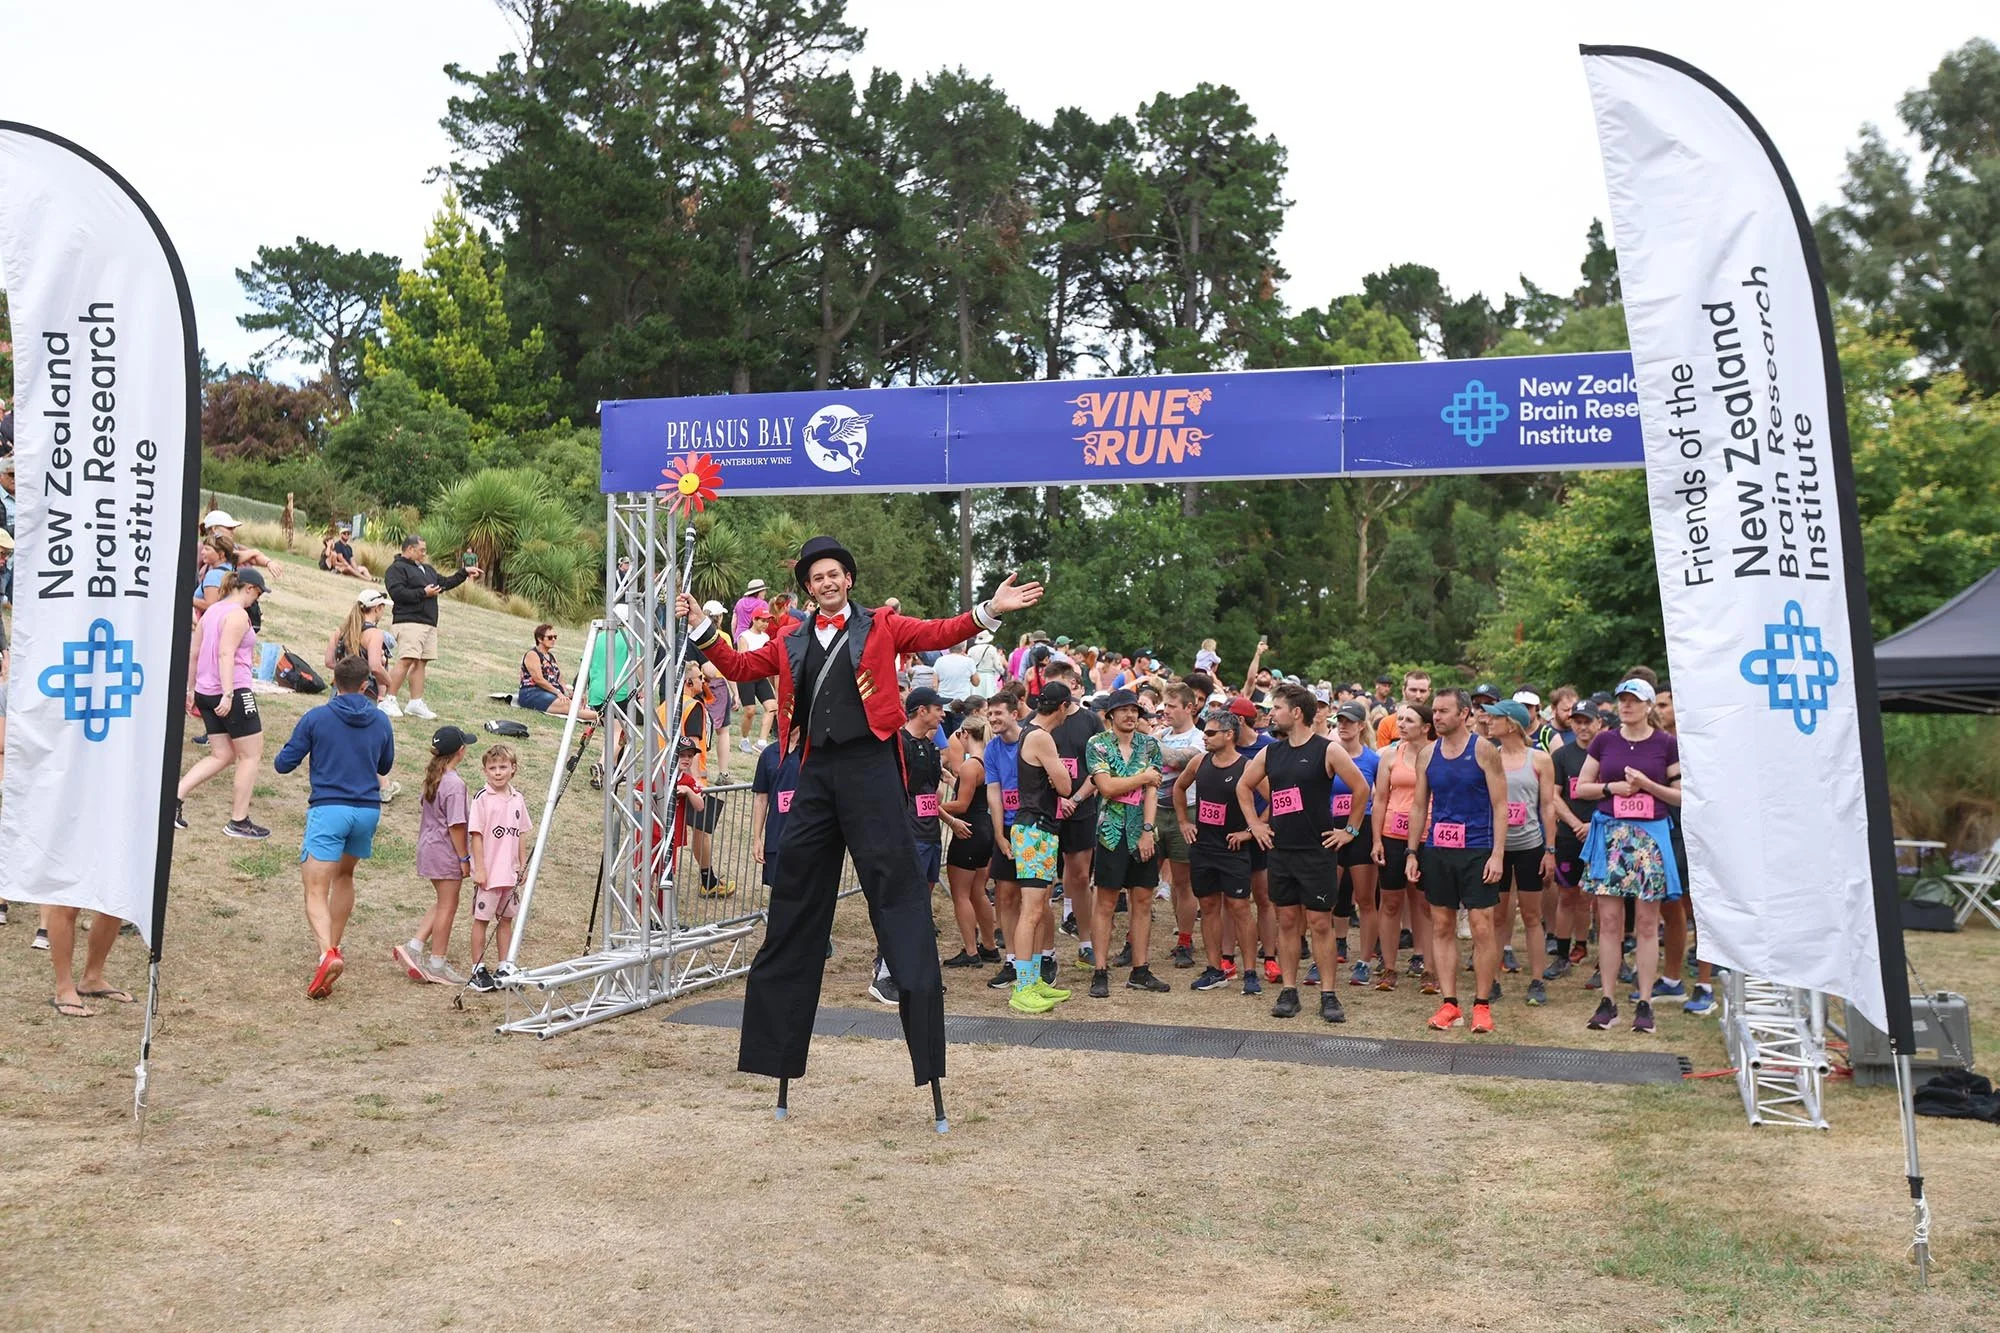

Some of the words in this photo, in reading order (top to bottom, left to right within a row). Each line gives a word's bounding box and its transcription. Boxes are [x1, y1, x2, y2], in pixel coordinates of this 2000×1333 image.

[1741, 265, 1785, 455] Research
[78, 302, 117, 484] Research
[1519, 377, 1572, 398] New
[1665, 364, 1697, 418] the
[1701, 300, 1761, 473] Zealand
[42, 331, 73, 497] Zealand
[1087, 388, 1190, 428] VINE
[1519, 399, 1578, 421] Brain
[1585, 398, 1639, 419] Rese
[666, 418, 749, 450] PEGASUS
[758, 416, 795, 447] BAY
[1094, 427, 1190, 466] RUN
[1519, 423, 1613, 446] Institute
[1668, 429, 1702, 459] of
[769, 456, 792, 466] WINE
[1792, 413, 1830, 581] Institute
[124, 439, 158, 599] Institute
[1675, 469, 1714, 587] Friends
[1732, 480, 1771, 578] New
[1771, 471, 1800, 579] Brain
[38, 508, 74, 599] New
[84, 499, 117, 598] Brain
[921, 800, 937, 811] 305
[1005, 795, 1018, 805] 48
[1201, 807, 1220, 820] 338
[1273, 795, 1292, 810] 359
[1336, 800, 1350, 810] 48
[1620, 800, 1644, 812] 580
[1396, 818, 1409, 830] 38
[1438, 830, 1459, 842] 454
